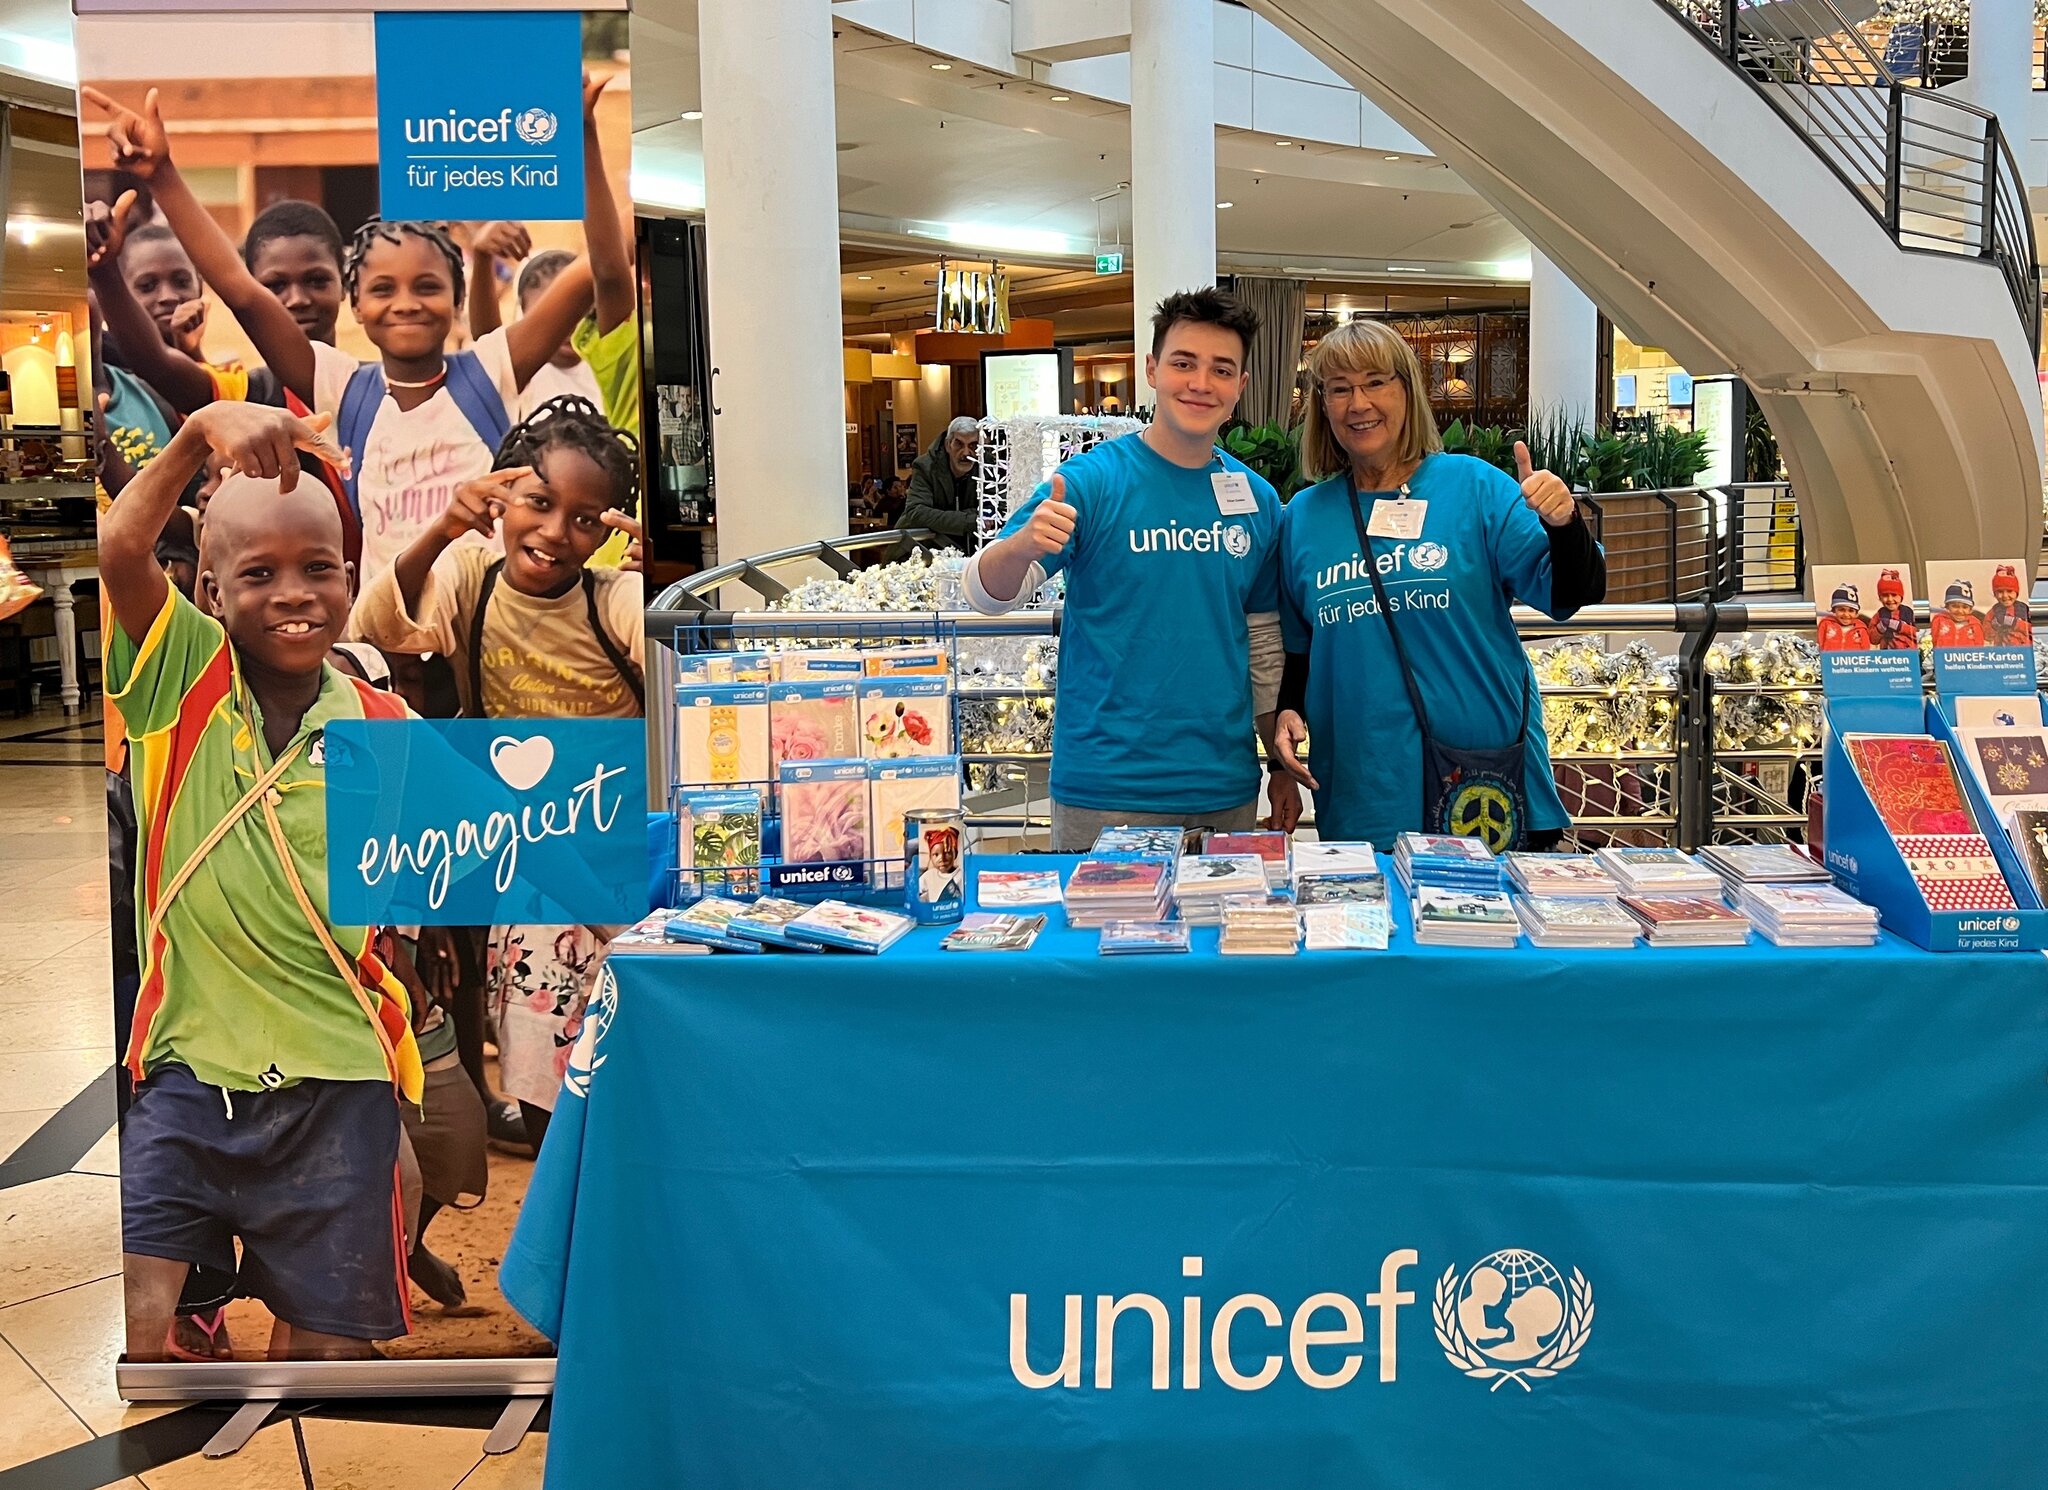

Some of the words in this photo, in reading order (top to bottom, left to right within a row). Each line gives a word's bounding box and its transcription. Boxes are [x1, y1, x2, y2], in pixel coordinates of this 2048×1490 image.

[405, 108, 512, 143] unicef
[407, 164, 437, 187] für
[443, 165, 504, 191] jedes
[510, 165, 558, 187] Kind
[1129, 520, 1222, 553] unicef
[1316, 544, 1405, 589] unicef
[1318, 604, 1341, 627] für
[1404, 588, 1450, 610] Kind
[1831, 656, 1910, 666] UNICEF-Karten
[1943, 652, 2024, 662] UNICEF-Karten
[823, 685, 844, 693] unicef
[912, 682, 933, 691] unicef
[733, 691, 755, 699] unicef
[834, 714, 844, 752] Danke
[834, 766, 854, 775] unicef
[357, 763, 627, 910] engagiert
[1828, 849, 1850, 870] unicef
[780, 867, 830, 883] unicef
[932, 902, 953, 911] unicef
[1958, 917, 2002, 931] unicef
[1958, 938, 1971, 947] für
[1971, 938, 1997, 949] jedes
[1998, 938, 2019, 947] Kind
[1009, 1249, 1418, 1390] unicef
